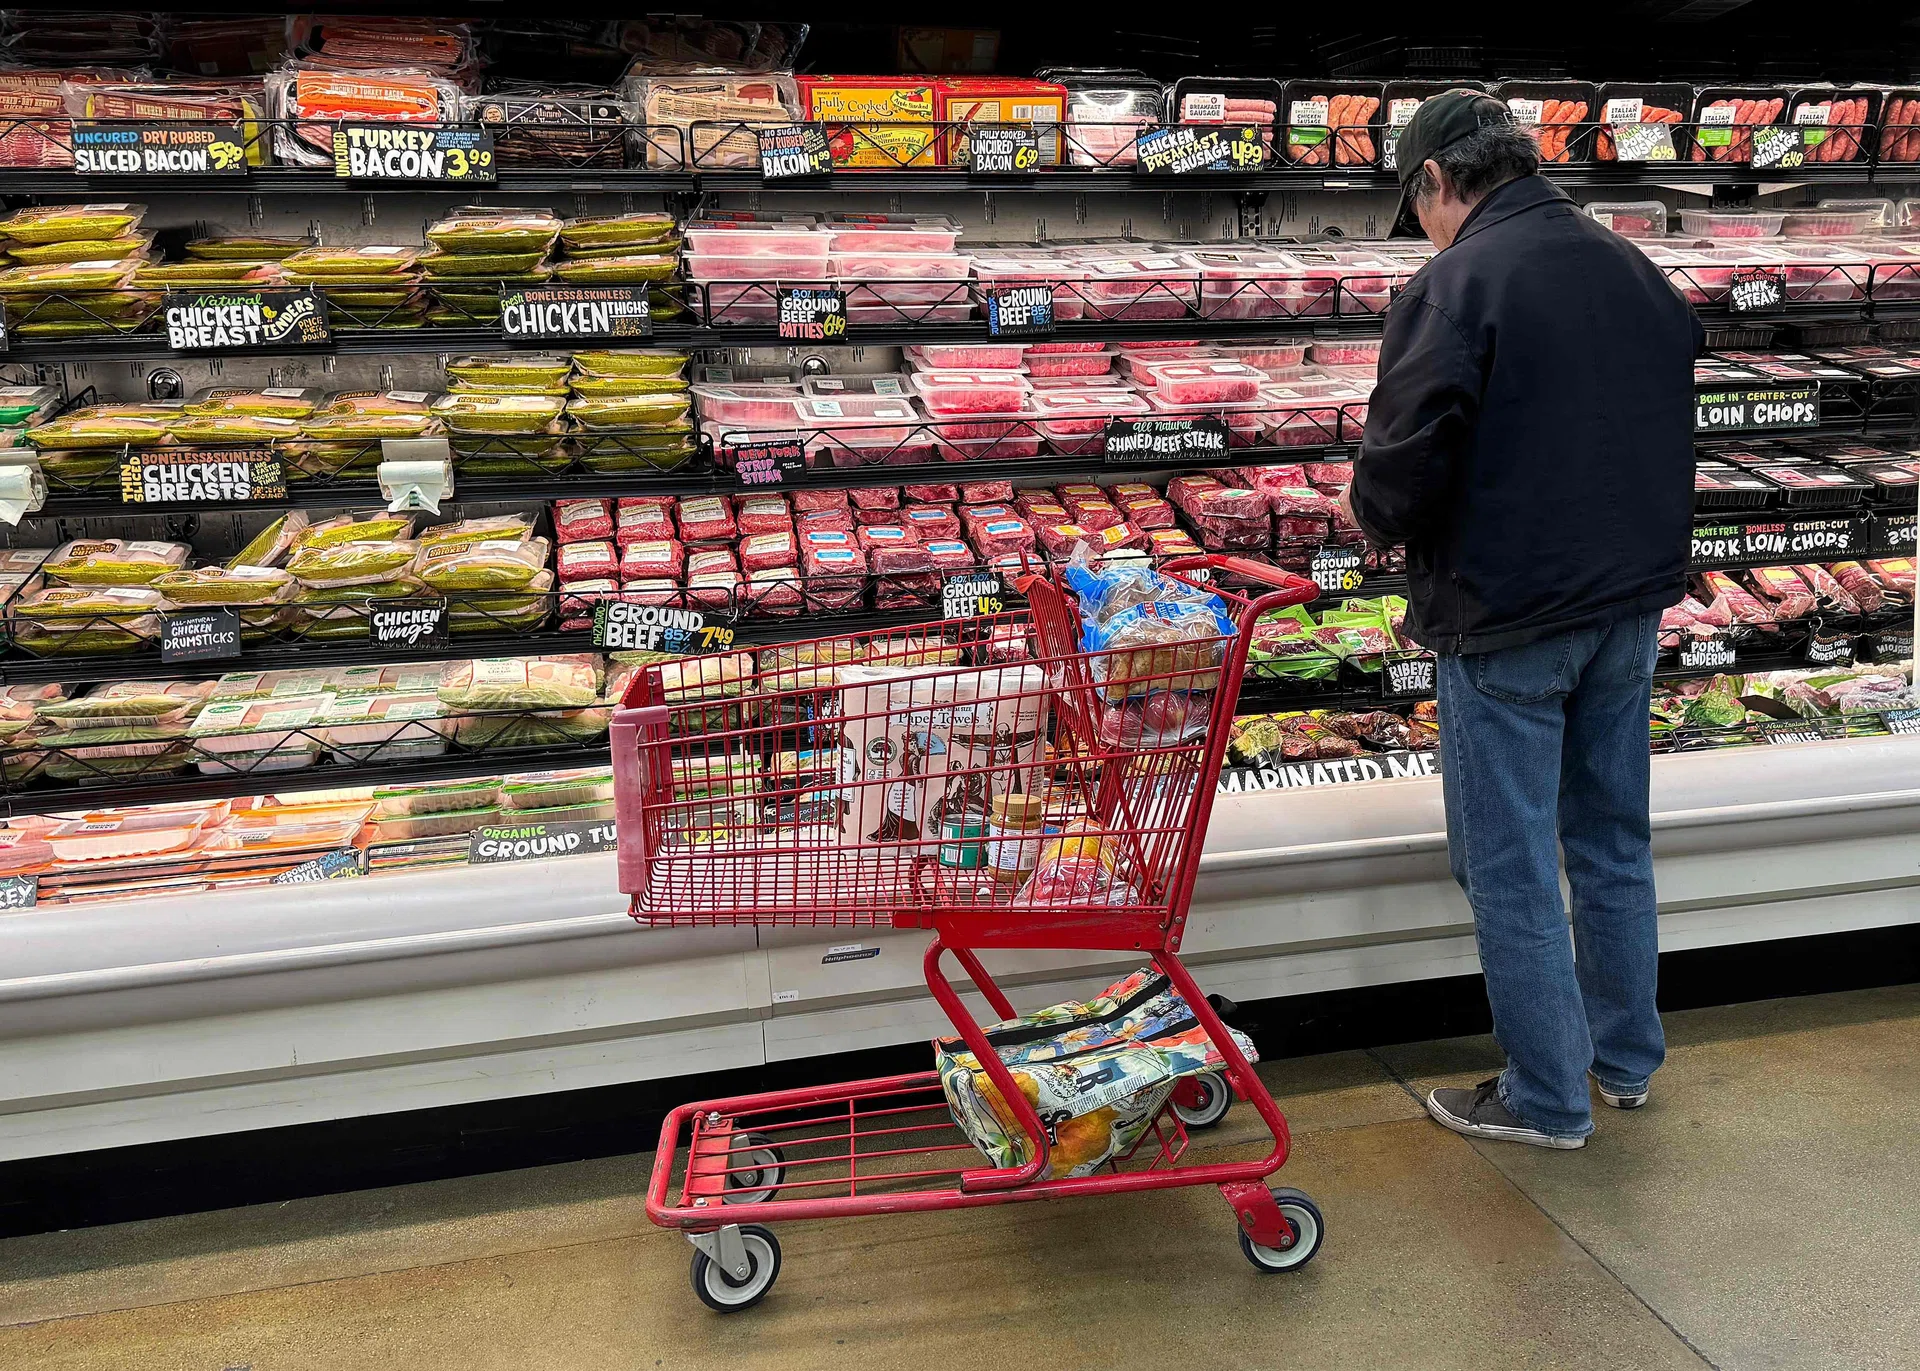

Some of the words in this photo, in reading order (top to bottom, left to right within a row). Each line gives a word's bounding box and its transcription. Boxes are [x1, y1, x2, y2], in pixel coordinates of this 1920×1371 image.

[813, 96, 846, 113] Fully
[847, 100, 894, 117] Cooked
[74, 132, 139, 143] UNCURED
[143, 130, 168, 145] DRY
[170, 131, 216, 144] RUBBED
[348, 128, 435, 151] TURKEY
[759, 137, 775, 150] DRY
[775, 134, 805, 149] RUBBED
[764, 129, 776, 138] NO
[776, 127, 802, 136] SUGAR
[979, 130, 1000, 140] FULLY
[1000, 130, 1027, 140] COOKED
[1138, 127, 1196, 159] CHICKEN
[1615, 123, 1642, 142] ITALIAN
[1622, 126, 1651, 148] PORK
[1757, 130, 1787, 155] PORK
[333, 131, 351, 177] UNCURED
[761, 147, 801, 157] UNCURED
[971, 139, 1014, 155] UNCURED
[1142, 131, 1220, 173] BREAKFAST
[1618, 126, 1665, 161] SAUSAGE
[1753, 131, 1800, 168] SAUSAGE
[75, 149, 142, 172] SLICED
[144, 149, 207, 172] BACON
[350, 148, 445, 178] BACON
[446, 148, 492, 177] 3.99
[762, 152, 811, 177] BACON
[976, 154, 1013, 171] BACON
[1171, 140, 1231, 174] SAUSAGE
[1755, 274, 1779, 283] CHOICE
[998, 288, 1052, 308] GROUND
[1731, 279, 1769, 300] FLANK
[1736, 285, 1780, 311] STEAK
[189, 293, 264, 308] Natural
[500, 292, 525, 311] Fresh
[781, 297, 841, 313] GROUND
[166, 304, 262, 328] CHICKEN
[262, 296, 315, 338] TENDERS
[503, 301, 610, 334] CHICKEN
[606, 300, 649, 316] THIGHS
[780, 309, 816, 323] BEEF
[988, 296, 999, 335] KOSHER
[998, 305, 1031, 327] BEEF
[1030, 304, 1052, 316] 85%
[168, 325, 260, 349] BREAST
[779, 322, 825, 340] PATTIES
[1700, 393, 1726, 405] BONE
[1728, 392, 1740, 402] IN
[1747, 391, 1810, 401] CENTER-CUT
[1155, 420, 1193, 432] natural
[1696, 404, 1745, 429] LOIN
[1753, 402, 1816, 425] CHOPS
[1107, 433, 1153, 452] SHAVED
[1152, 434, 1182, 453] BEEF
[1183, 431, 1224, 449] STEAK
[737, 448, 768, 461] NEW
[768, 445, 801, 459] YORK
[142, 462, 250, 484] CHICKEN
[735, 458, 775, 474] STRIP
[120, 464, 134, 503] THIN
[129, 456, 145, 503] SLICED
[741, 469, 783, 485] STEAK
[144, 482, 251, 503] BREASTS
[1692, 527, 1718, 538] CRATE
[1719, 525, 1739, 536] FREE
[1745, 523, 1786, 535] BONELESS
[1792, 520, 1850, 532] CENTER-CUT
[1691, 537, 1741, 558] PORK
[1745, 533, 1788, 554] LOIN
[1791, 531, 1850, 553] CHOPS
[1311, 556, 1361, 571] GROUND
[942, 580, 1000, 599] GROUND
[373, 609, 441, 627] CHICKEN
[608, 602, 704, 632] GROUND
[943, 595, 978, 620] BEEF
[171, 616, 218, 628] ALL-NATURAL
[171, 623, 213, 637] CHICKEN
[163, 631, 235, 651] DRUMSTICKS
[378, 622, 435, 645] Wings
[605, 622, 664, 651] BEEF
[663, 627, 693, 642] 85%
[1691, 640, 1726, 654] PORK
[1808, 647, 1852, 661] TENDERLOIN
[1810, 640, 1833, 652] BONELESS
[1833, 638, 1848, 648] PORK
[1680, 649, 1736, 667] TENDERLOIN
[1388, 661, 1434, 680] RIBEYE
[1392, 675, 1432, 692] STEAK
[898, 711, 937, 726] Paper
[938, 711, 980, 724] Towels
[1216, 758, 1383, 794] MARINATED
[482, 825, 547, 840] ORGANIC
[477, 832, 581, 858] GROUND
[278, 860, 317, 881] GROUND
